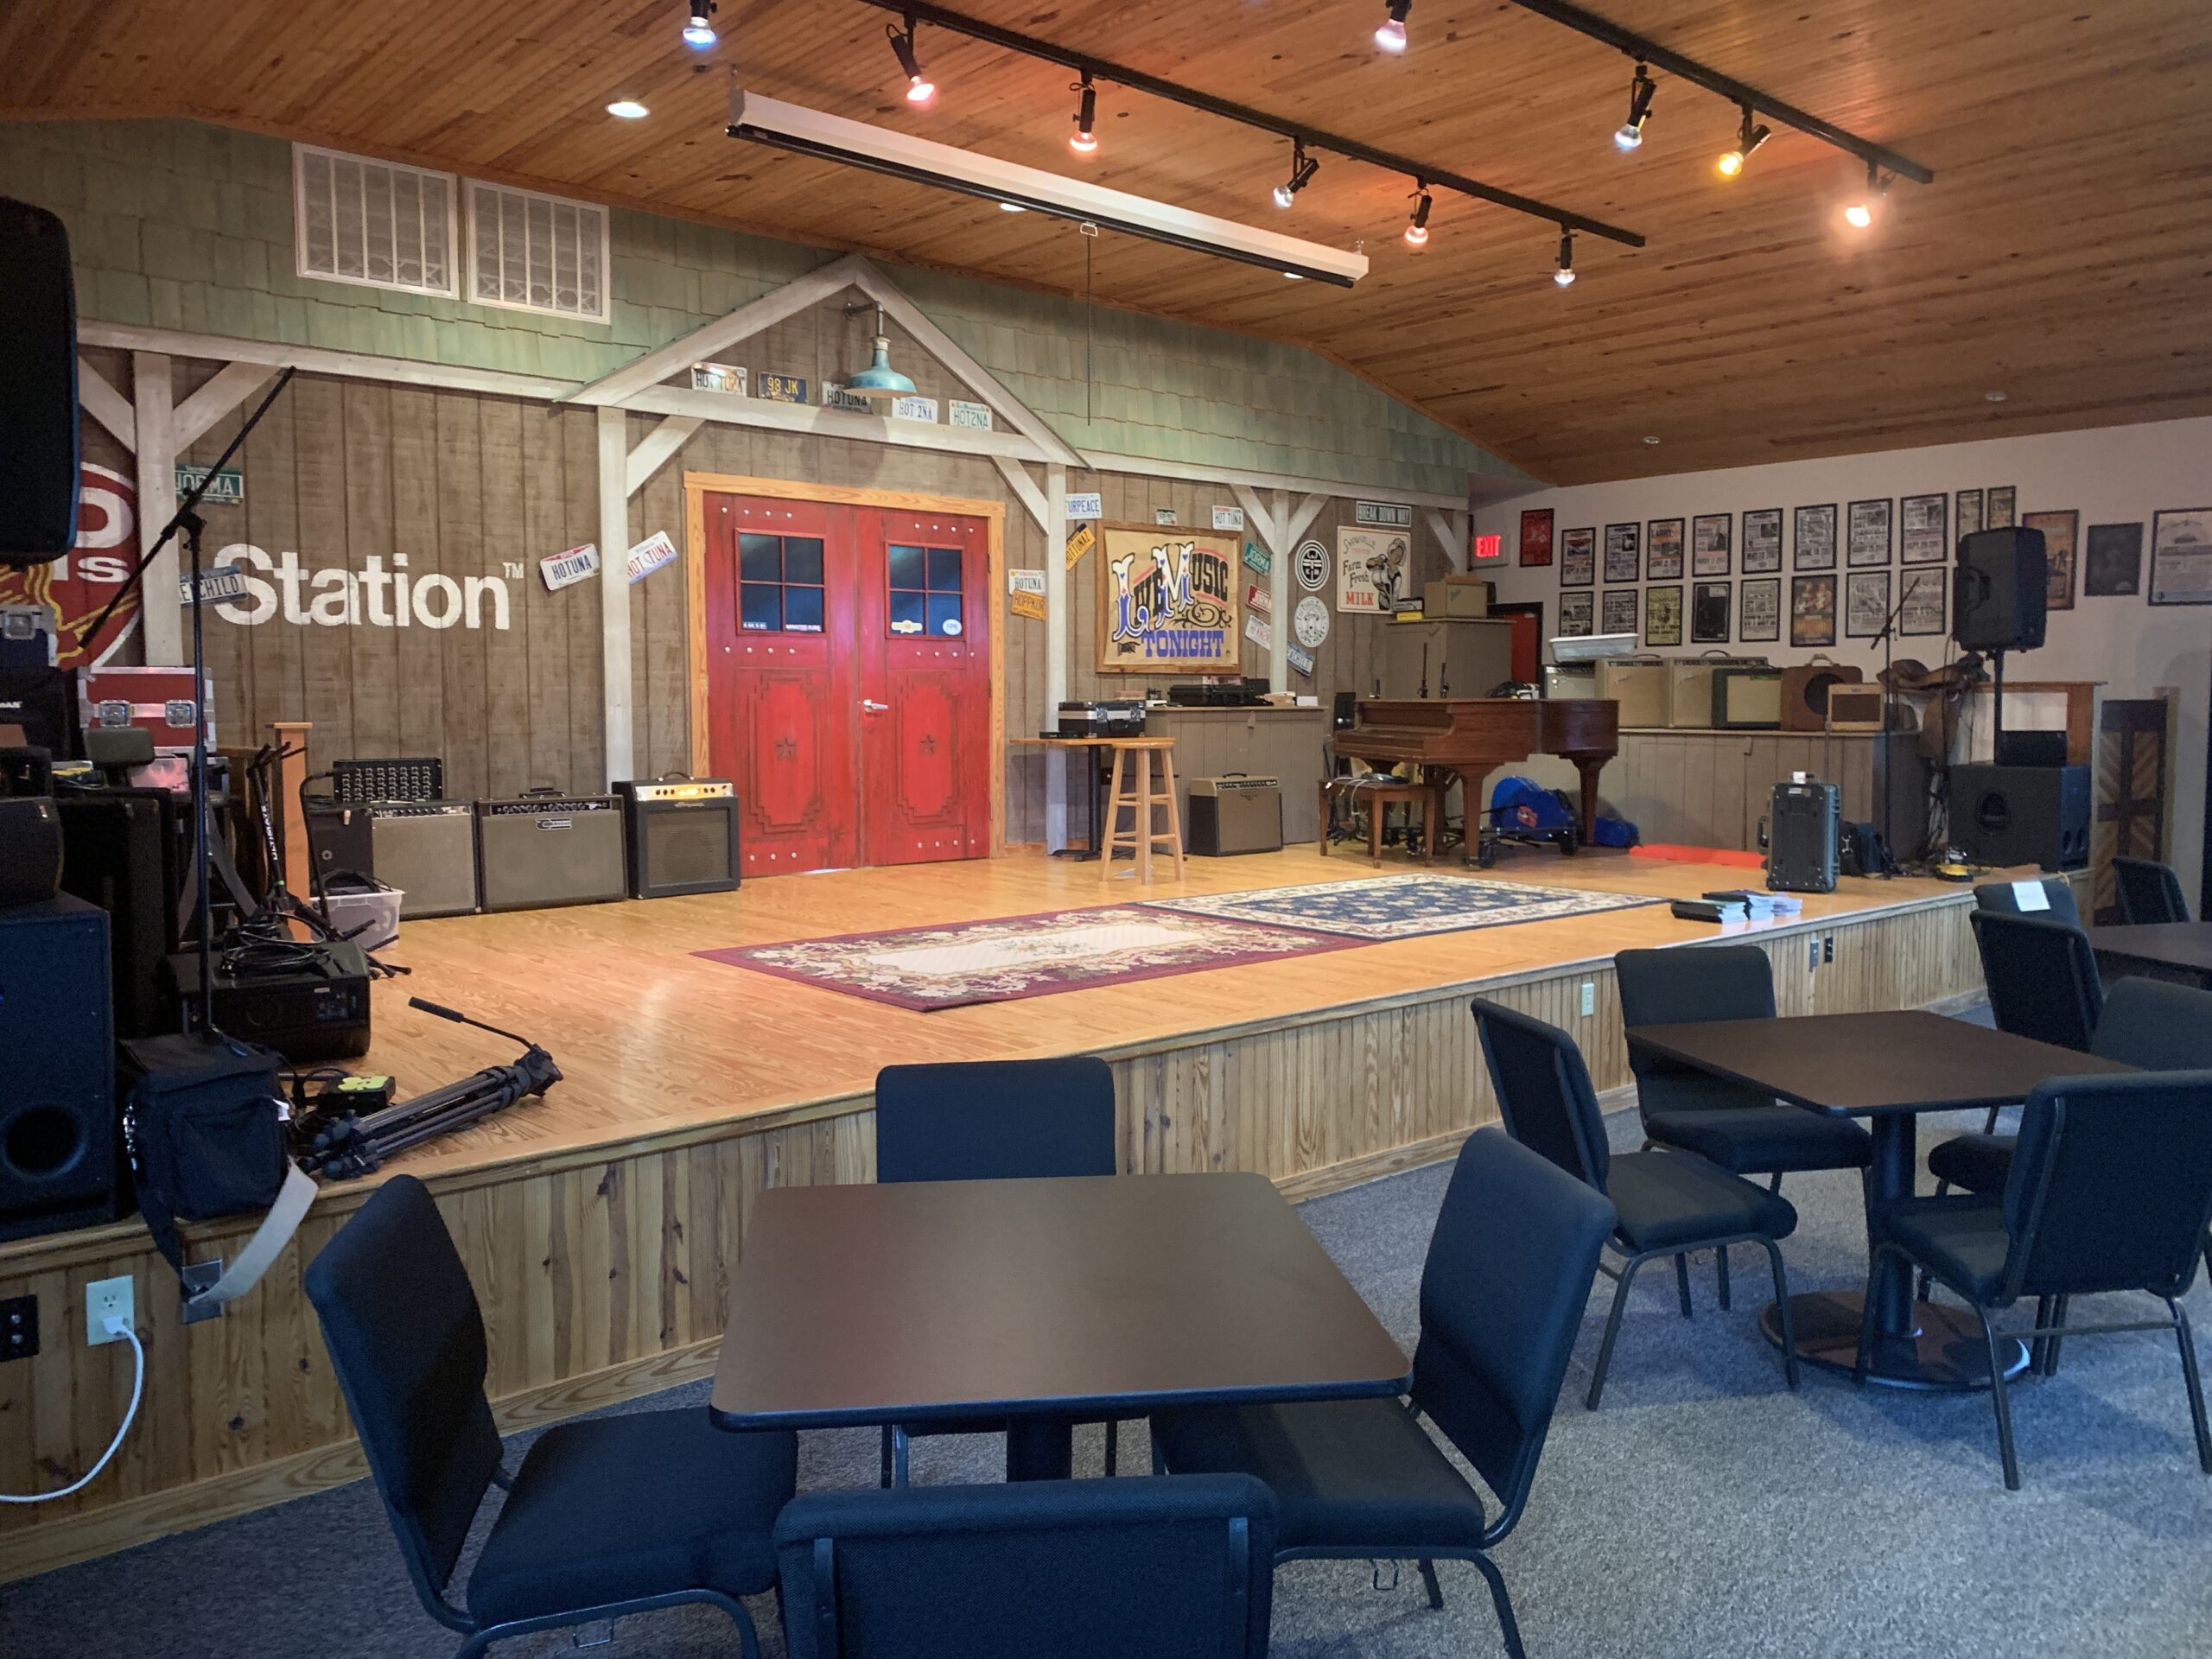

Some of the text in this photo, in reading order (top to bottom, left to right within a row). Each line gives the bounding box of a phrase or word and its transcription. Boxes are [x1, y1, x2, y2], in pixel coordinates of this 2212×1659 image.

[767, 377, 798, 395] 98 JK
[954, 410, 988, 427] HOT2NA
[1065, 499, 1100, 512] URPEACE
[1476, 535, 1501, 557] EXIT
[551, 554, 593, 581] HOTUNA
[628, 542, 672, 577] HOT TUNA
[1343, 560, 1362, 576] Farm
[213, 543, 510, 630] Station
[1014, 577, 1042, 589] HOTUNA
[1151, 541, 1229, 629] MUSIC
[1345, 591, 1375, 606] MILK
[1141, 629, 1224, 658] TONIGHT
